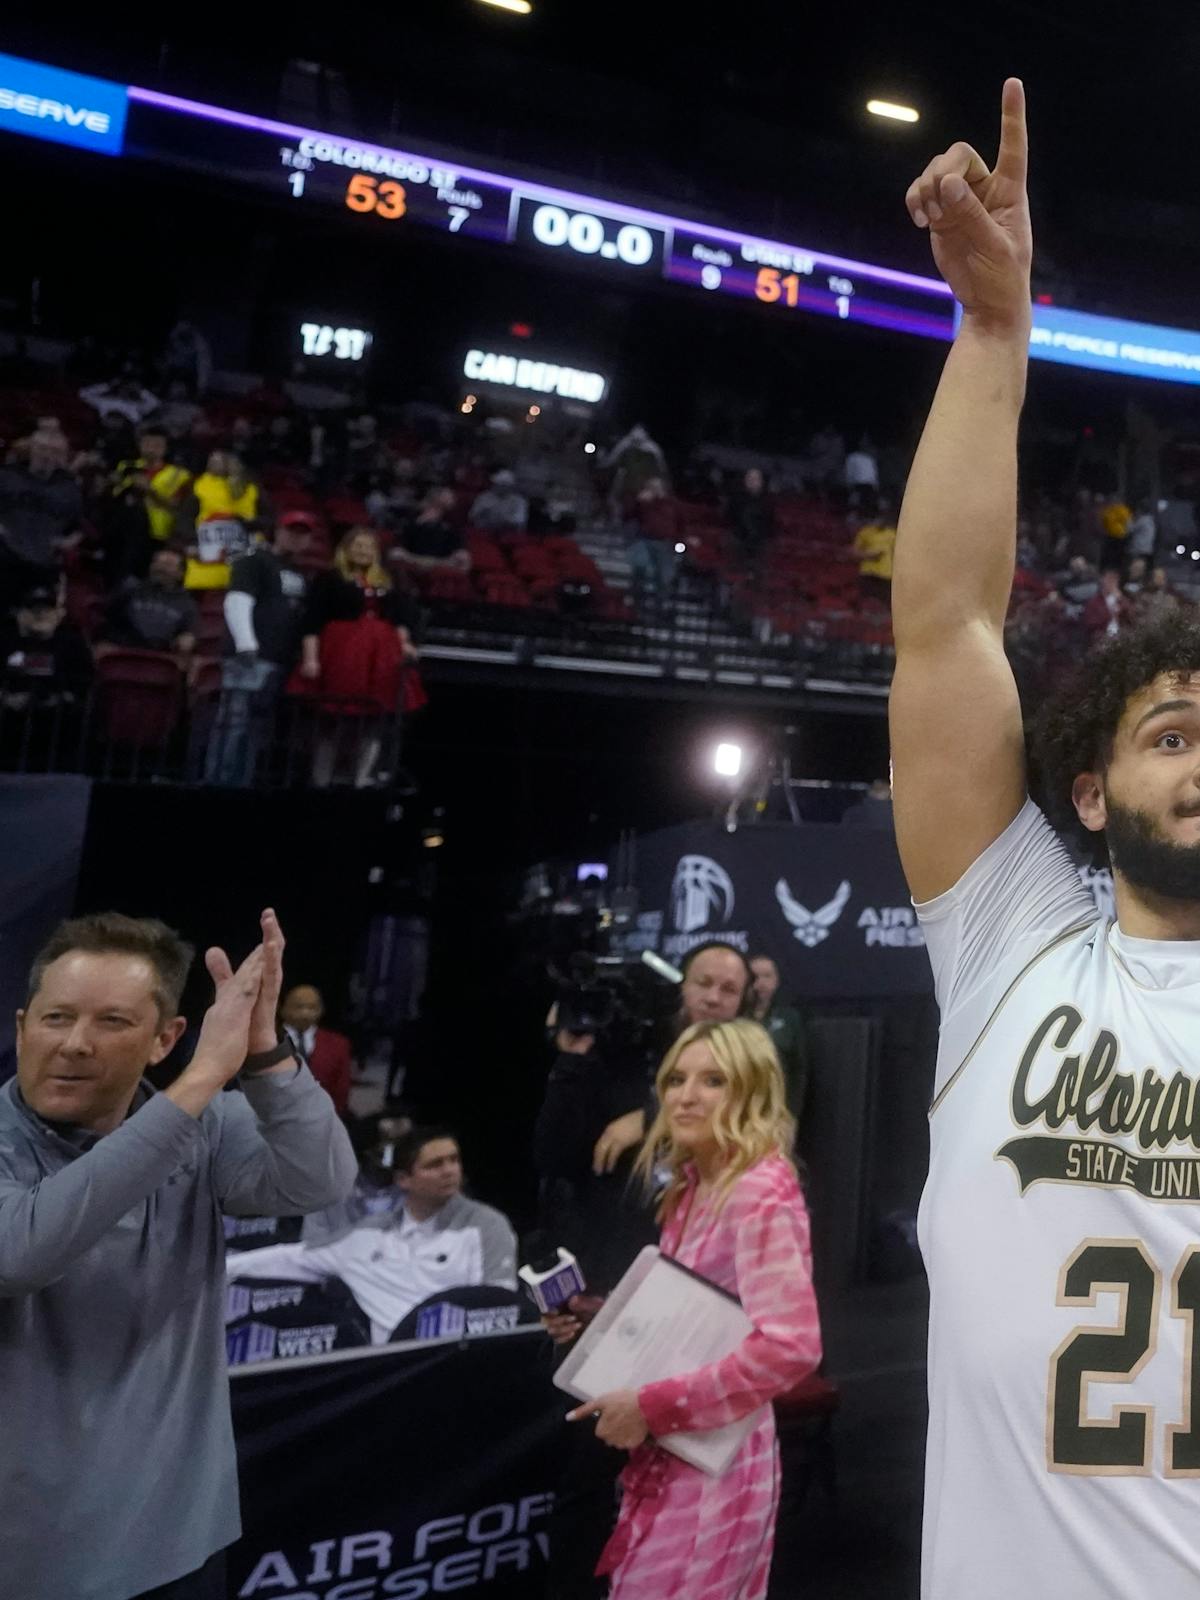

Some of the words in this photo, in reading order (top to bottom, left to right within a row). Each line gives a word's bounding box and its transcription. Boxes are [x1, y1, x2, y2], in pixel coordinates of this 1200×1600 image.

[299, 136, 430, 184] COLORADO
[288, 170, 306, 198] 1
[345, 173, 407, 220] 53
[447, 205, 470, 233] 7
[532, 204, 653, 265] 00.0
[701, 264, 722, 290] 9
[755, 267, 800, 307] 51
[835, 295, 850, 319] 1
[857, 906, 914, 928] AIR
[1065, 1142, 1138, 1185] STATE
[278, 1335, 333, 1356] WEST
[238, 1531, 393, 1598] AIR
[413, 1492, 555, 1560] FOR
